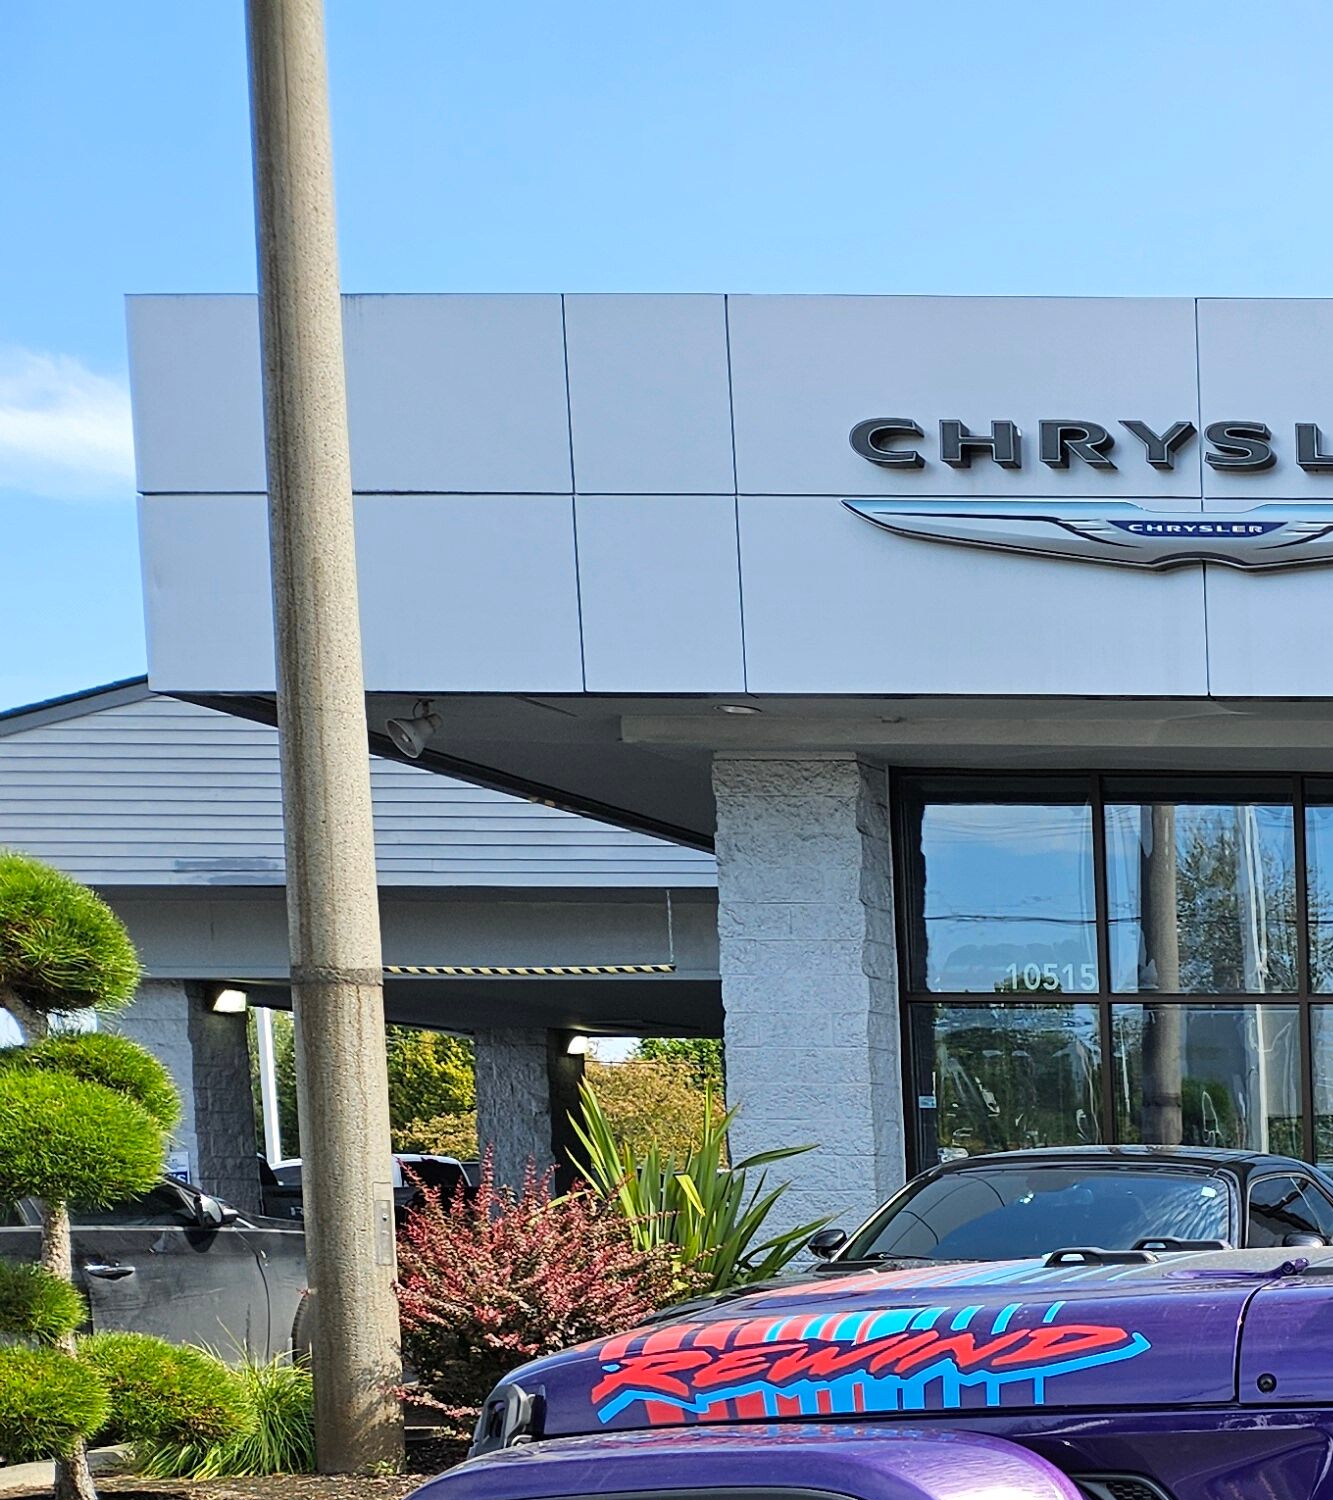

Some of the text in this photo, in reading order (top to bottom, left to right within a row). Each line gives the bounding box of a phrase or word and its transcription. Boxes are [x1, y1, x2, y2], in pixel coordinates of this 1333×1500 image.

[1127, 524, 1264, 533] CHRYSLER
[1006, 962, 1097, 991] 10515
[591, 1324, 1143, 1407] REWIND
